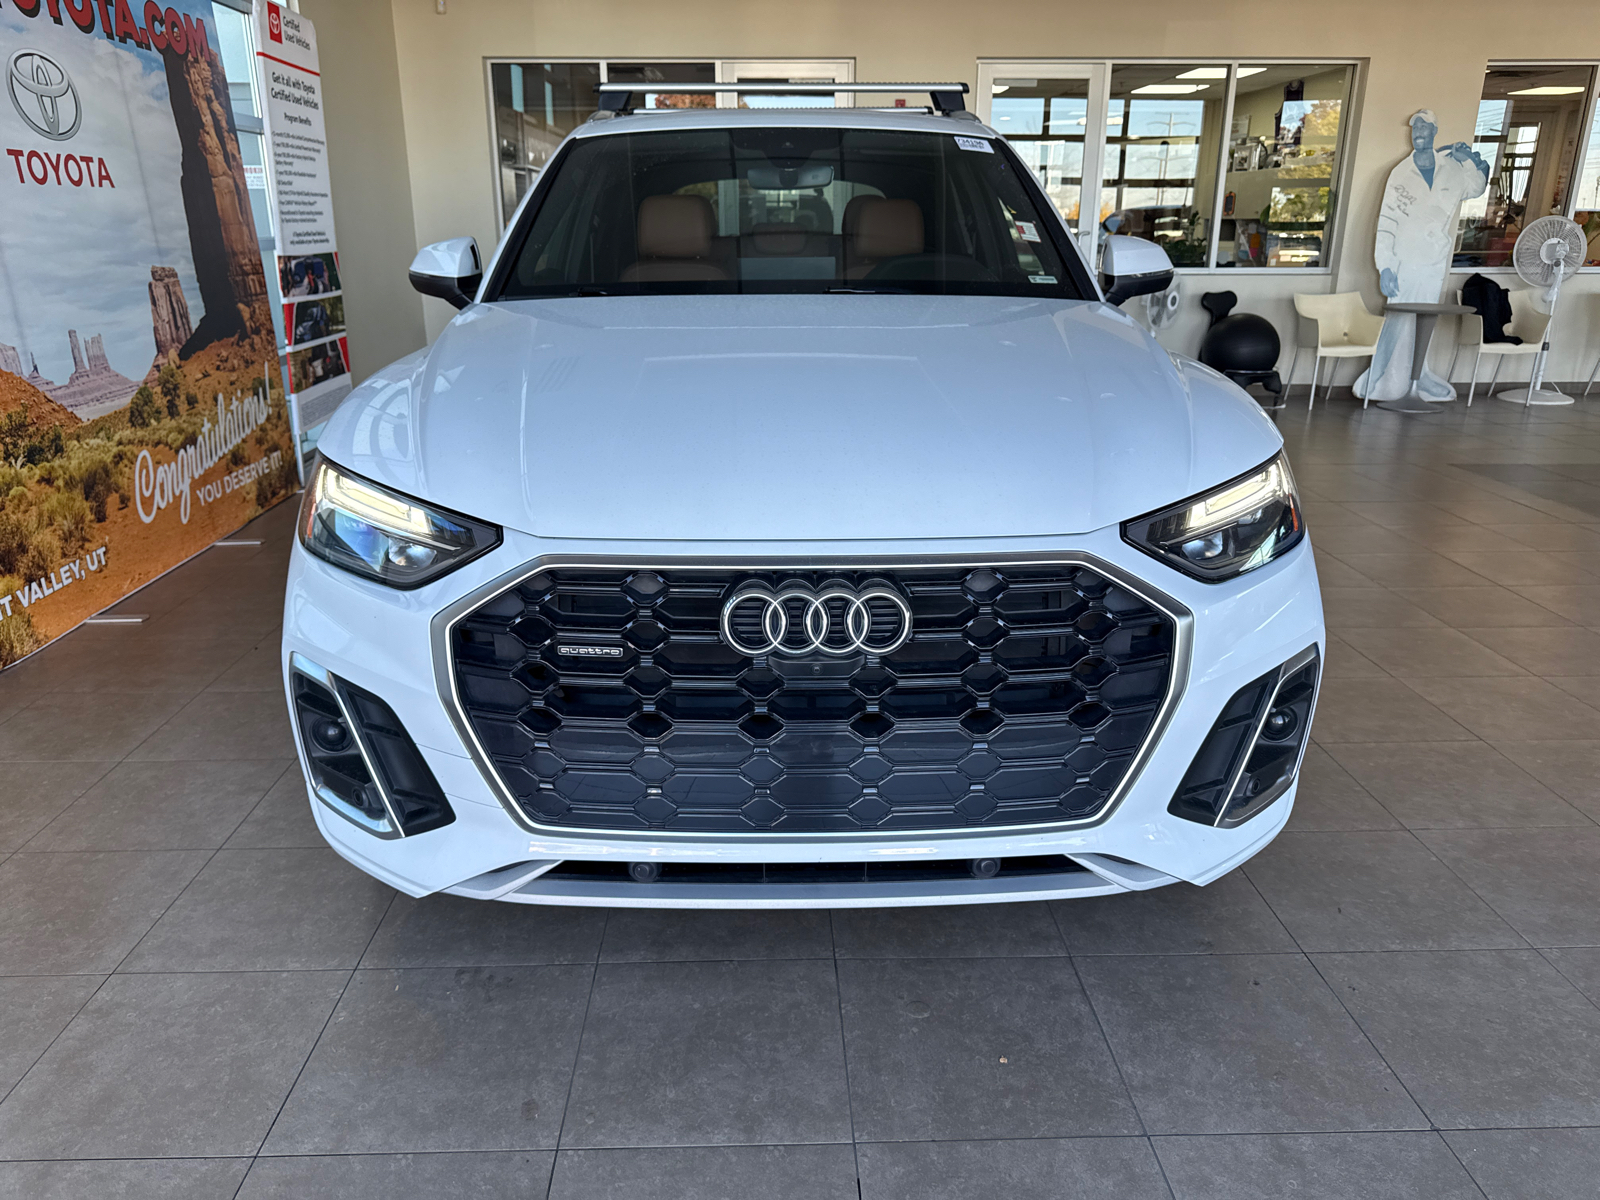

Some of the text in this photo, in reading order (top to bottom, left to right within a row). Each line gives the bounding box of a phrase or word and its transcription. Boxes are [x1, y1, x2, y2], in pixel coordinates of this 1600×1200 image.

[0, 0, 210, 61] OTA.COM
[6, 148, 115, 188] TOYOTA
[135, 361, 273, 524] Congratulations!
[196, 450, 283, 506] YOU DESERVE IT!
[0, 547, 106, 621] T VALLEY, UT
[559, 647, 621, 655] quattro
